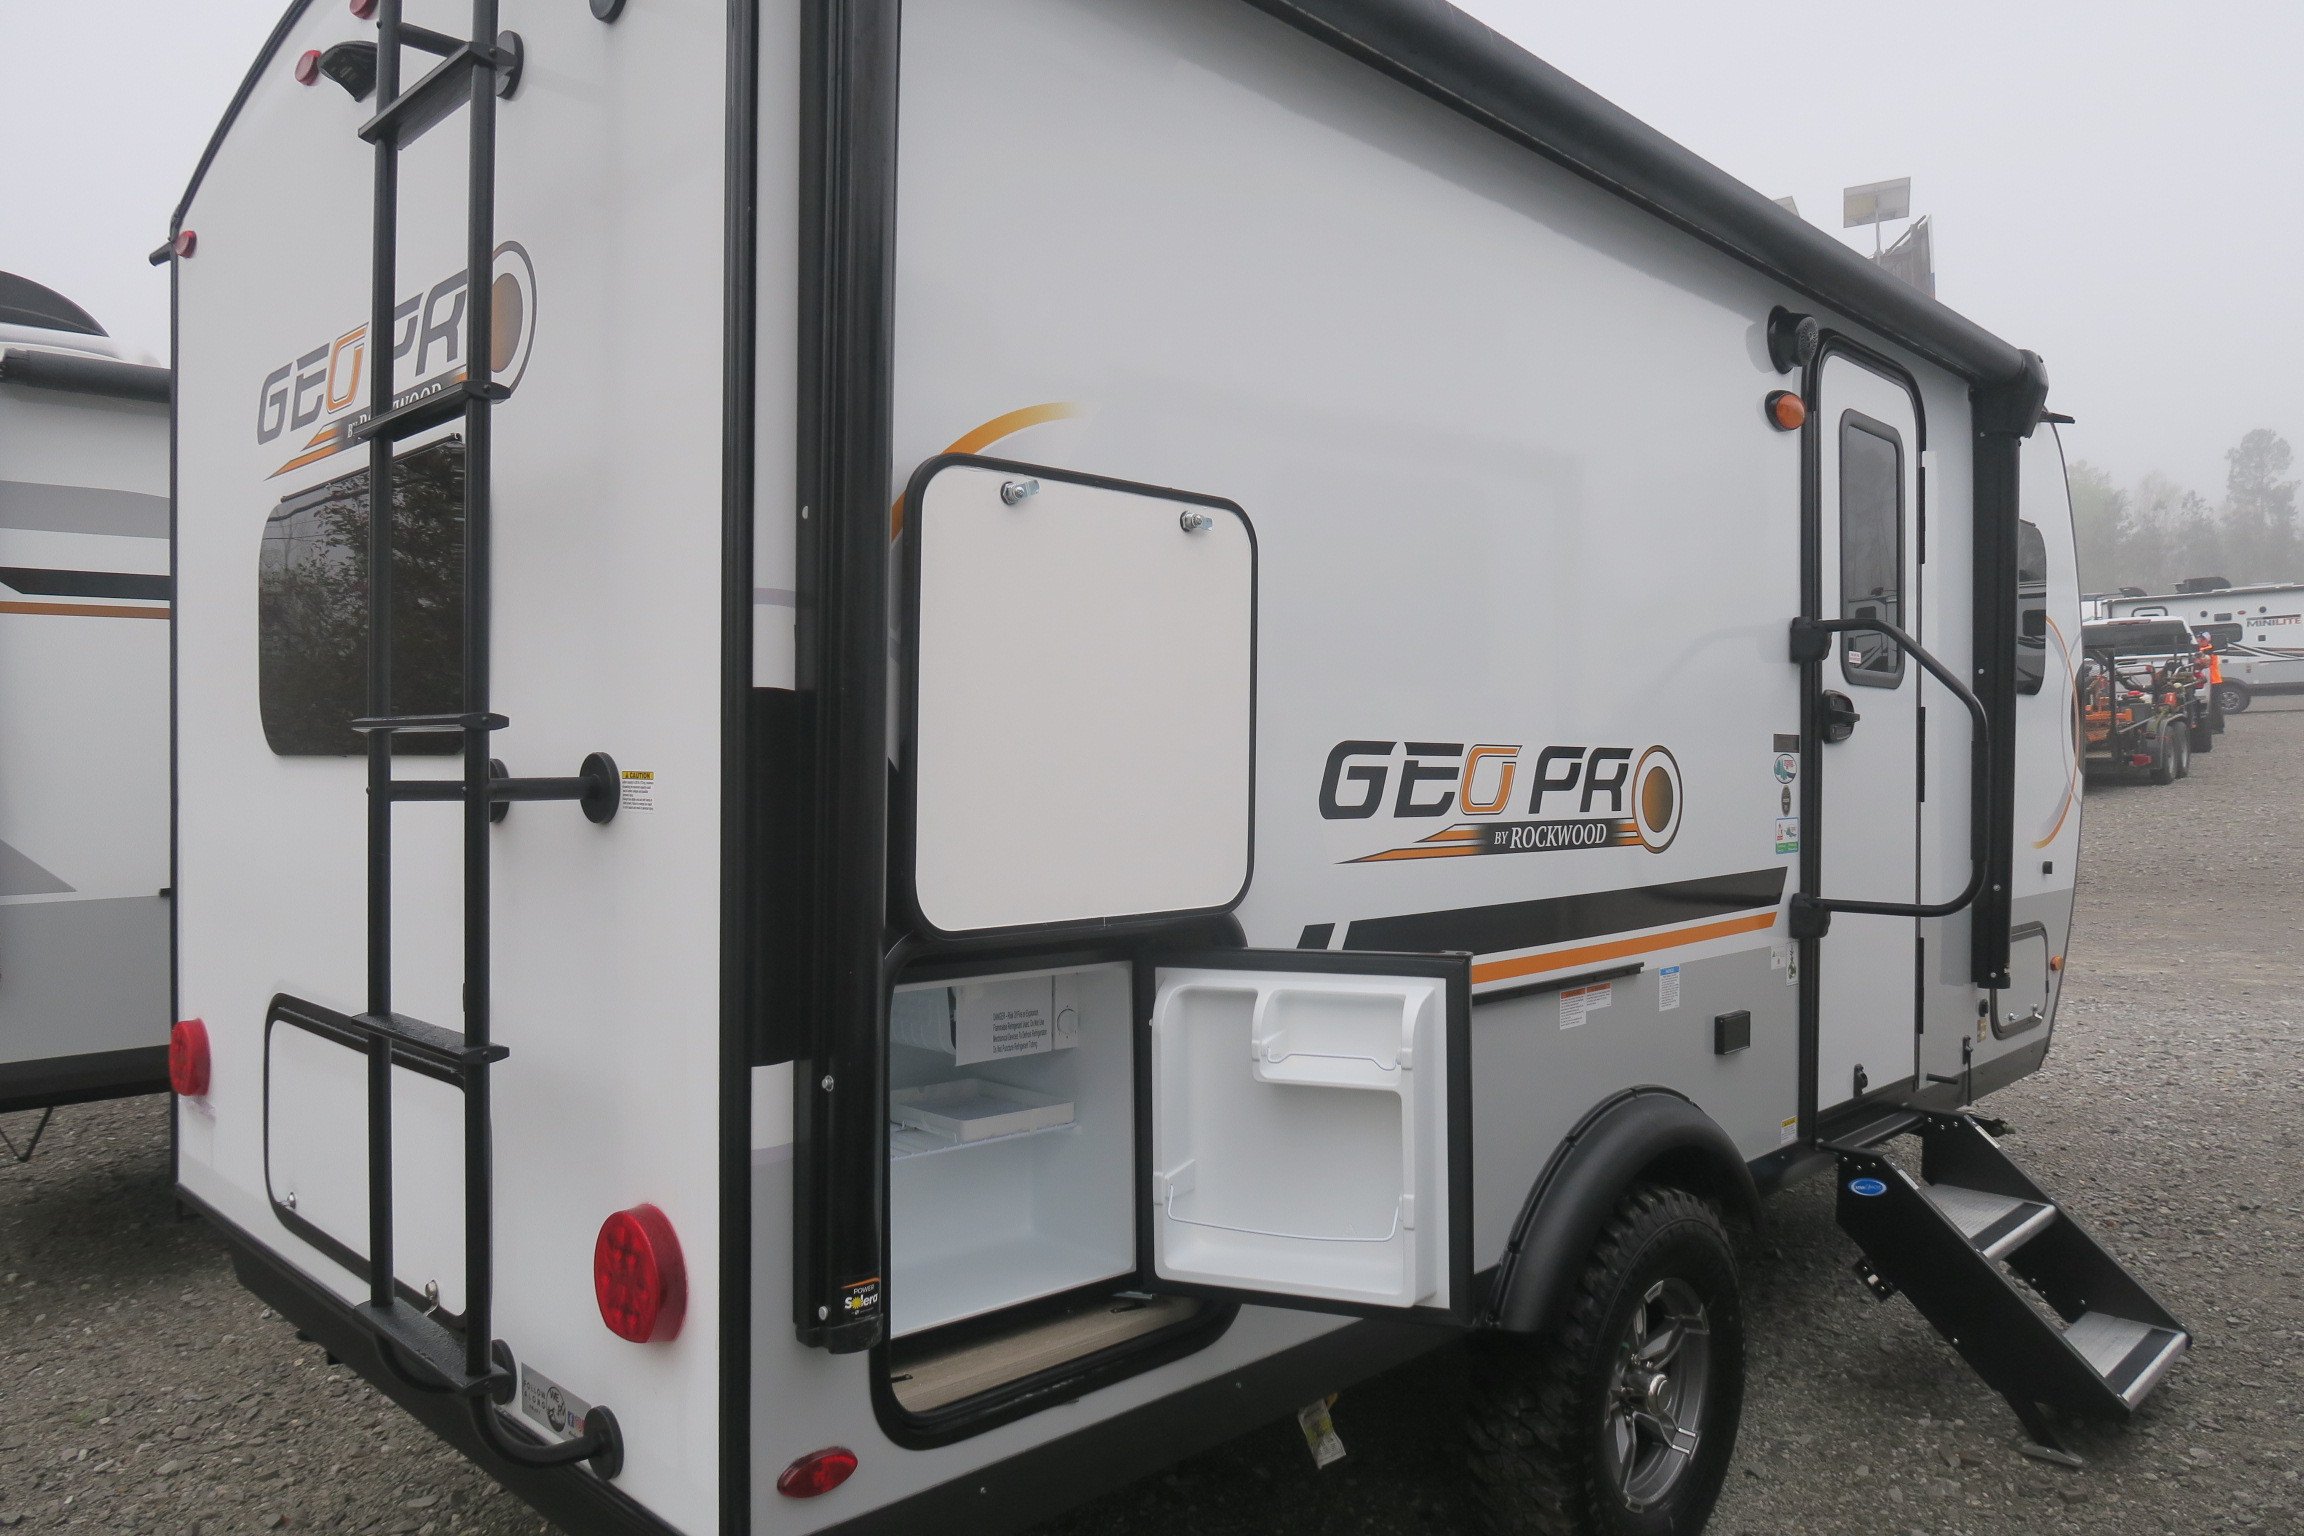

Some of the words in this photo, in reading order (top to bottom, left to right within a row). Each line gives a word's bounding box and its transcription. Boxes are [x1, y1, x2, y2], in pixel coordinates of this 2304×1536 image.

[257, 321, 370, 446] GEO
[1318, 739, 1523, 820] GEO
[1528, 744, 1684, 854] PRO
[1493, 831, 1509, 845] BY
[1509, 823, 1607, 849] ROCKWOOD
[853, 1284, 875, 1294] POWER
